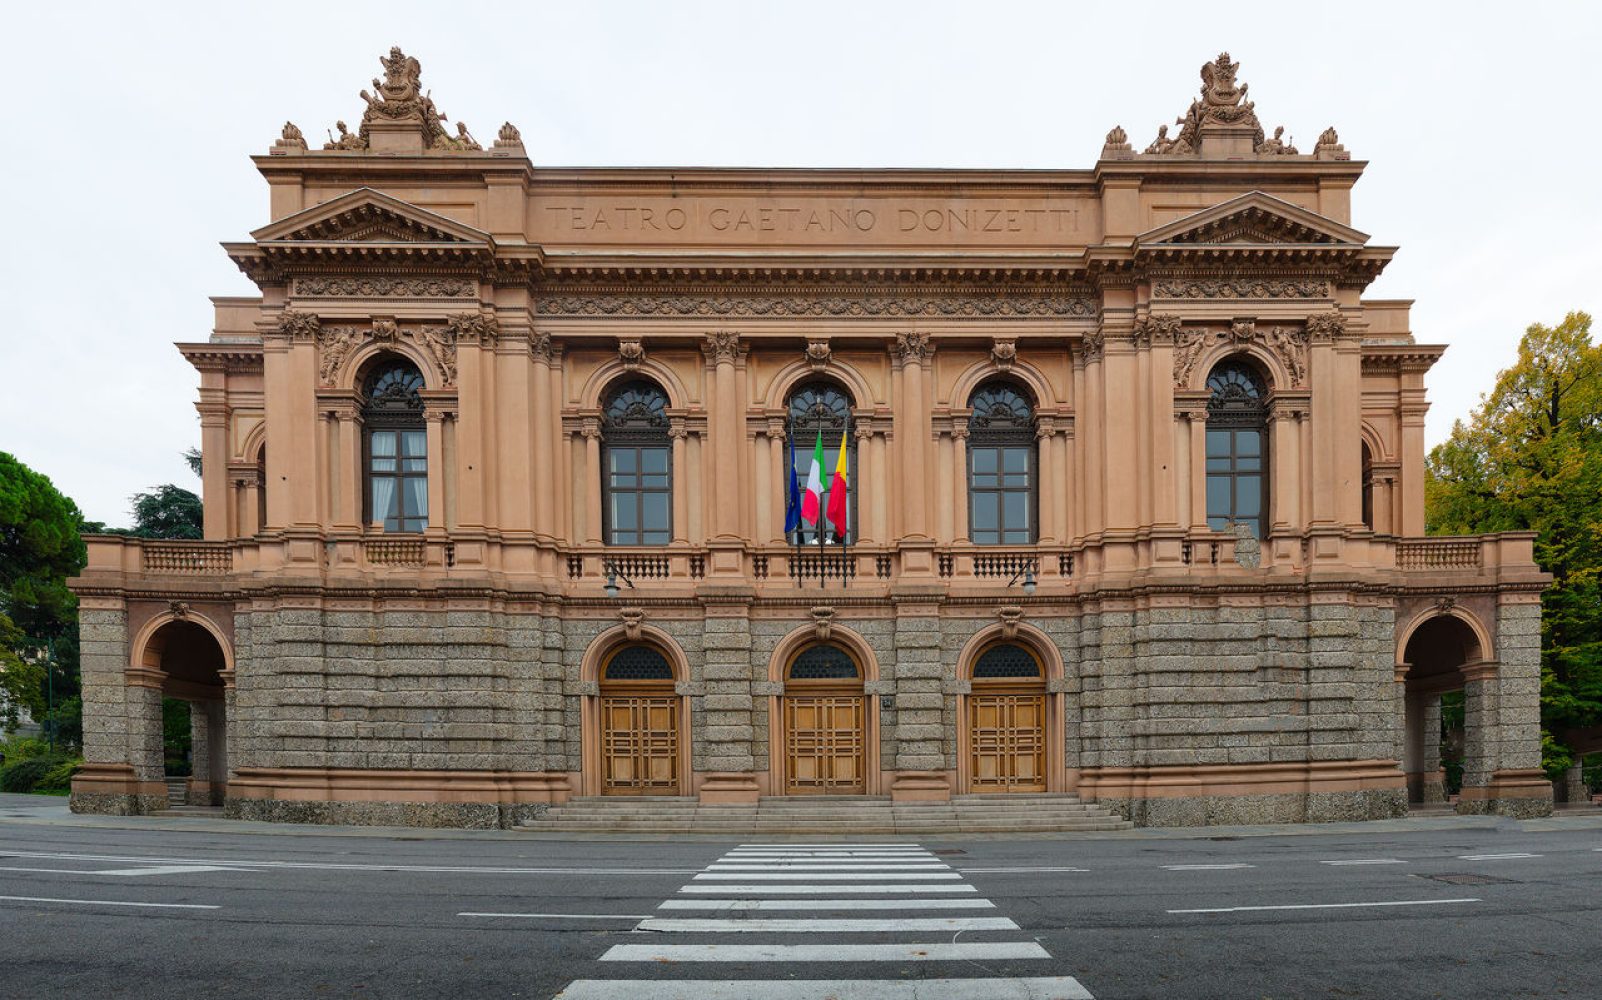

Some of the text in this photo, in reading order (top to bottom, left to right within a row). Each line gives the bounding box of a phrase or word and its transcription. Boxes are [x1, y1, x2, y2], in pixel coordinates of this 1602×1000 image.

[545, 207, 1080, 233] TEATRO GAETANO DONIZETTI
